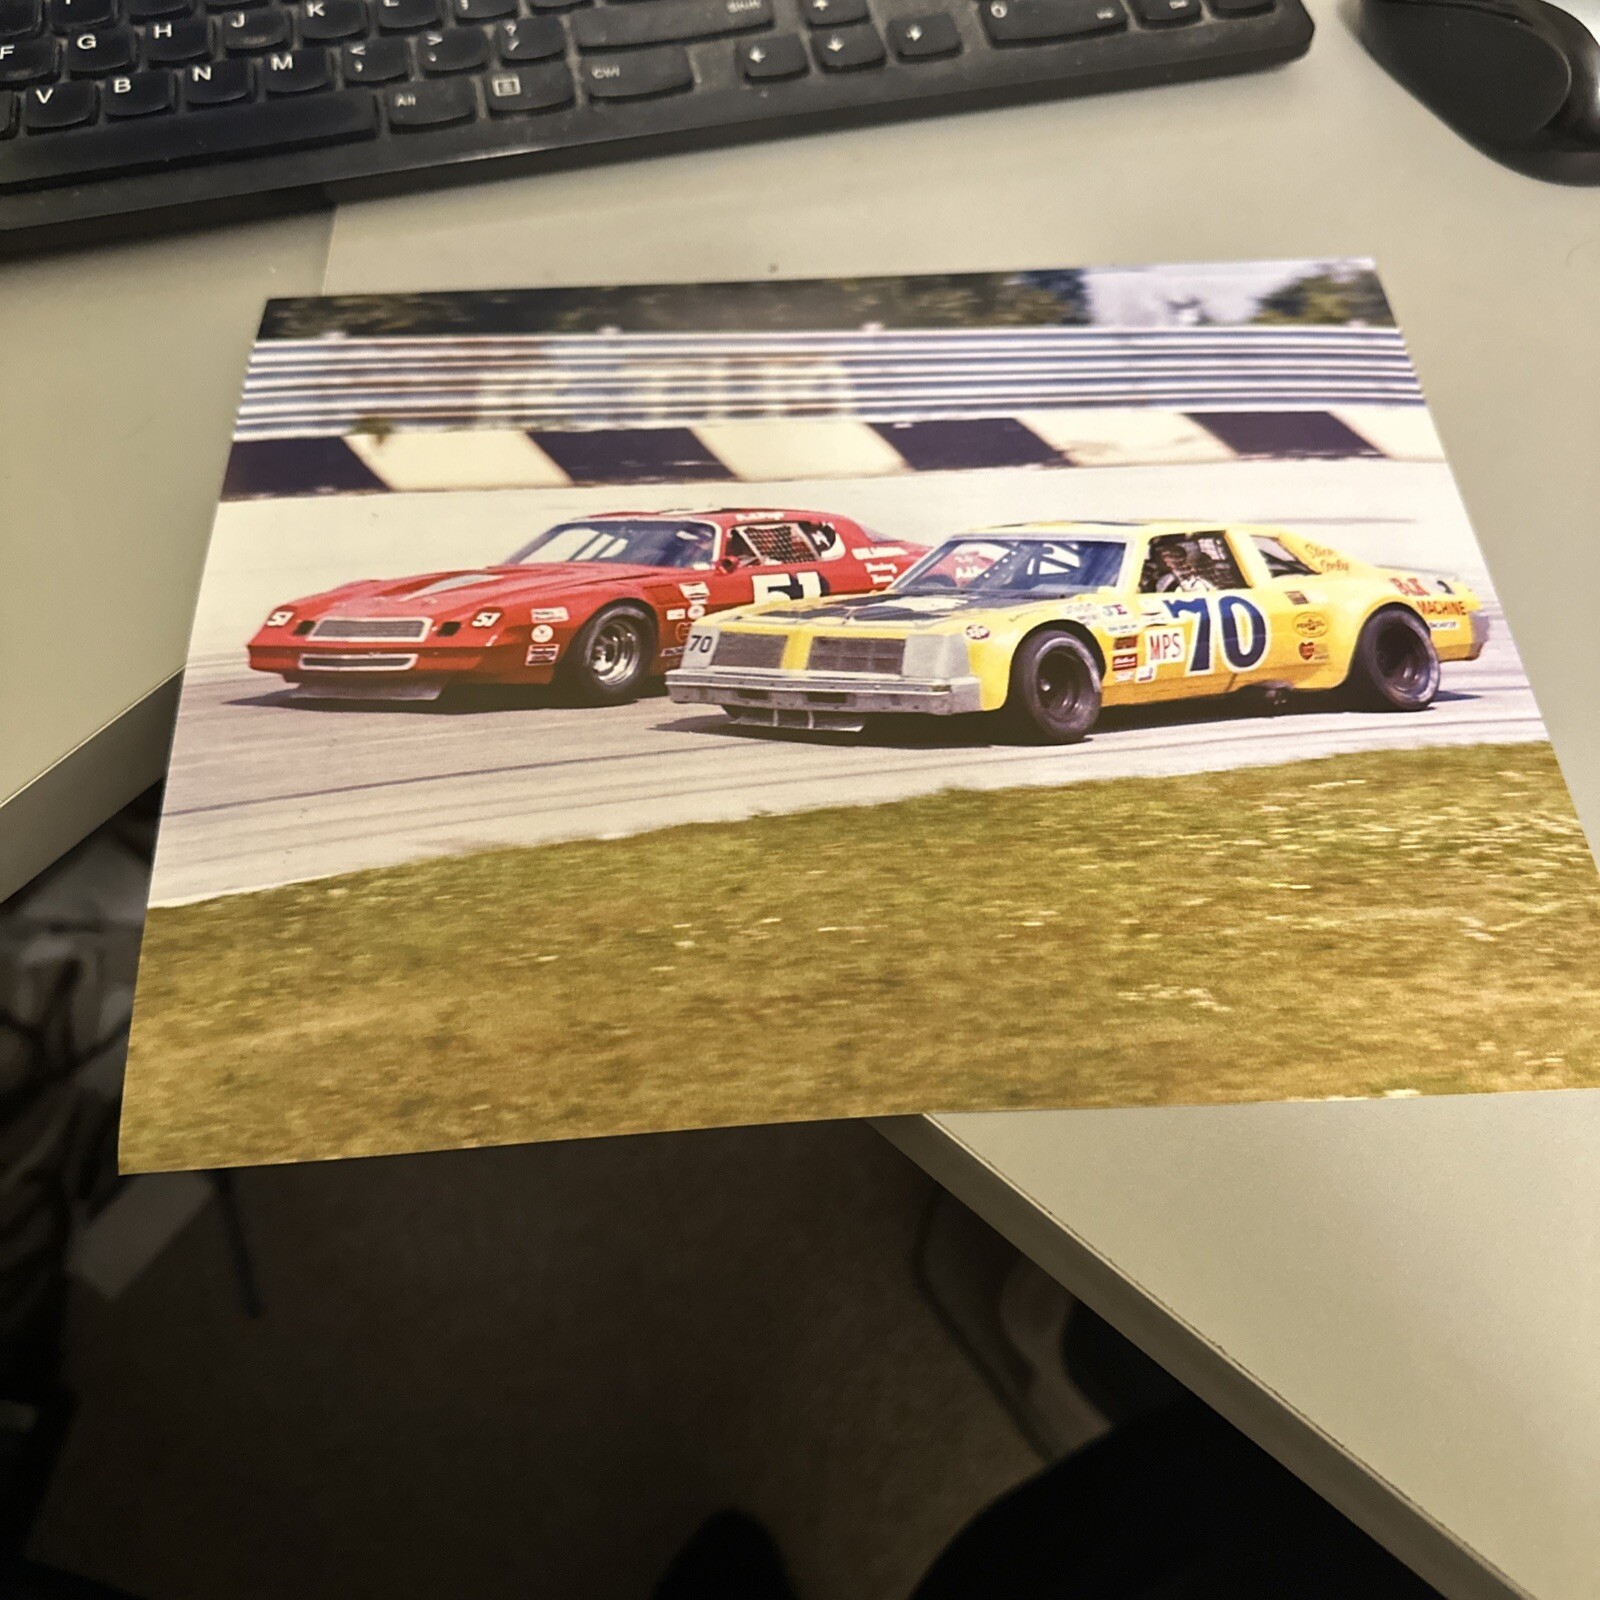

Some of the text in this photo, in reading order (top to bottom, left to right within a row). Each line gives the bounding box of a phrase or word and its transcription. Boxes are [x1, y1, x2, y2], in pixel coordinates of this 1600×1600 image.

[307, 2, 326, 17] K
[231, 12, 246, 28] J
[153, 22, 173, 39] H
[76, 34, 97, 50] G
[0, 44, 15, 60] F
[270, 53, 293, 71] M
[191, 65, 212, 82] N
[113, 77, 132, 94] B
[35, 88, 54, 104] V
[1415, 599, 1467, 617] MACHINE
[266, 611, 296, 627] 51
[471, 612, 502, 627] 51
[1161, 595, 1267, 671] 70
[689, 634, 713, 653] 70
[1149, 632, 1182, 661] MPS
